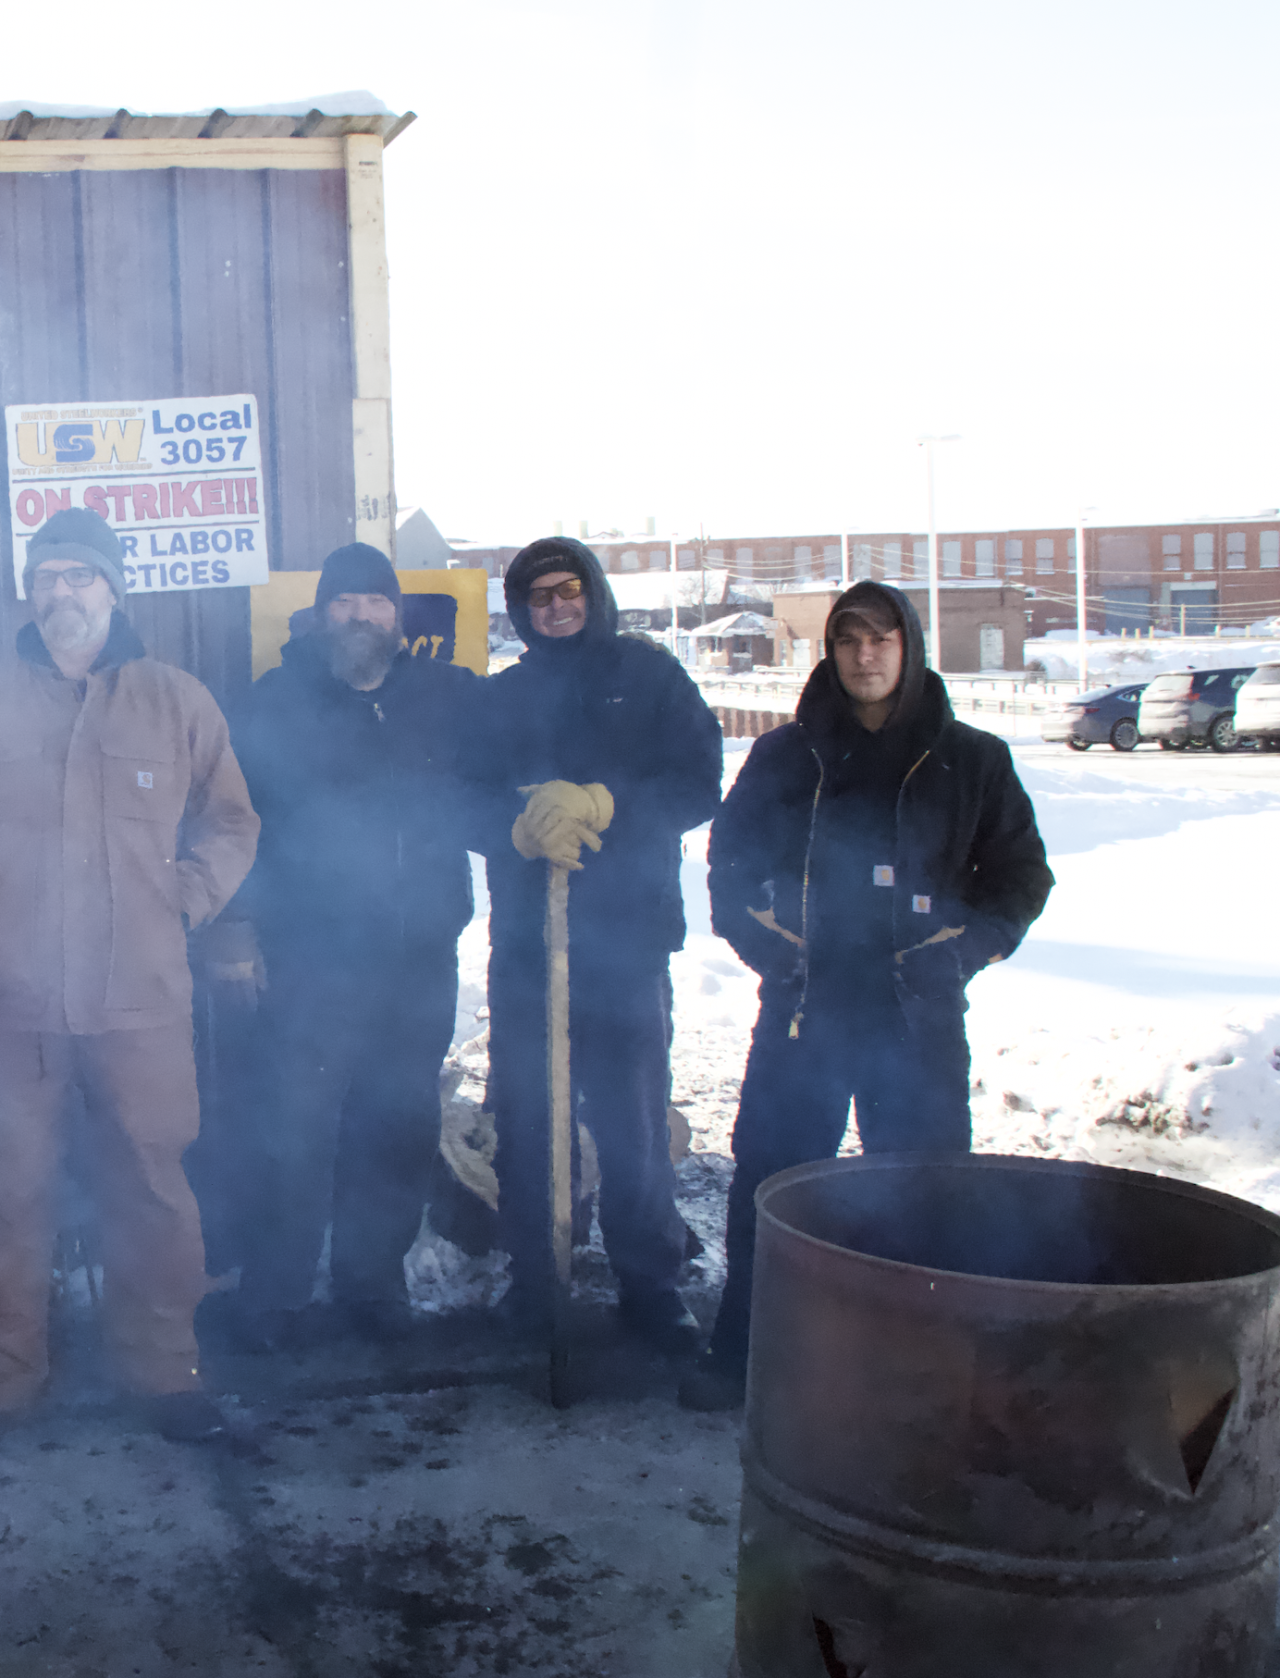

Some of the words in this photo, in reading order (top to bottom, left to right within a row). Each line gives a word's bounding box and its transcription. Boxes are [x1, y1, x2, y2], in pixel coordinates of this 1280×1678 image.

[21, 409, 58, 421] UNITED
[152, 404, 252, 435] Local
[16, 419, 145, 467] USW
[160, 436, 247, 465] 3057
[83, 477, 259, 523] STRIKE!!!
[150, 528, 255, 557] LABOR
[123, 559, 230, 589] CTICES
